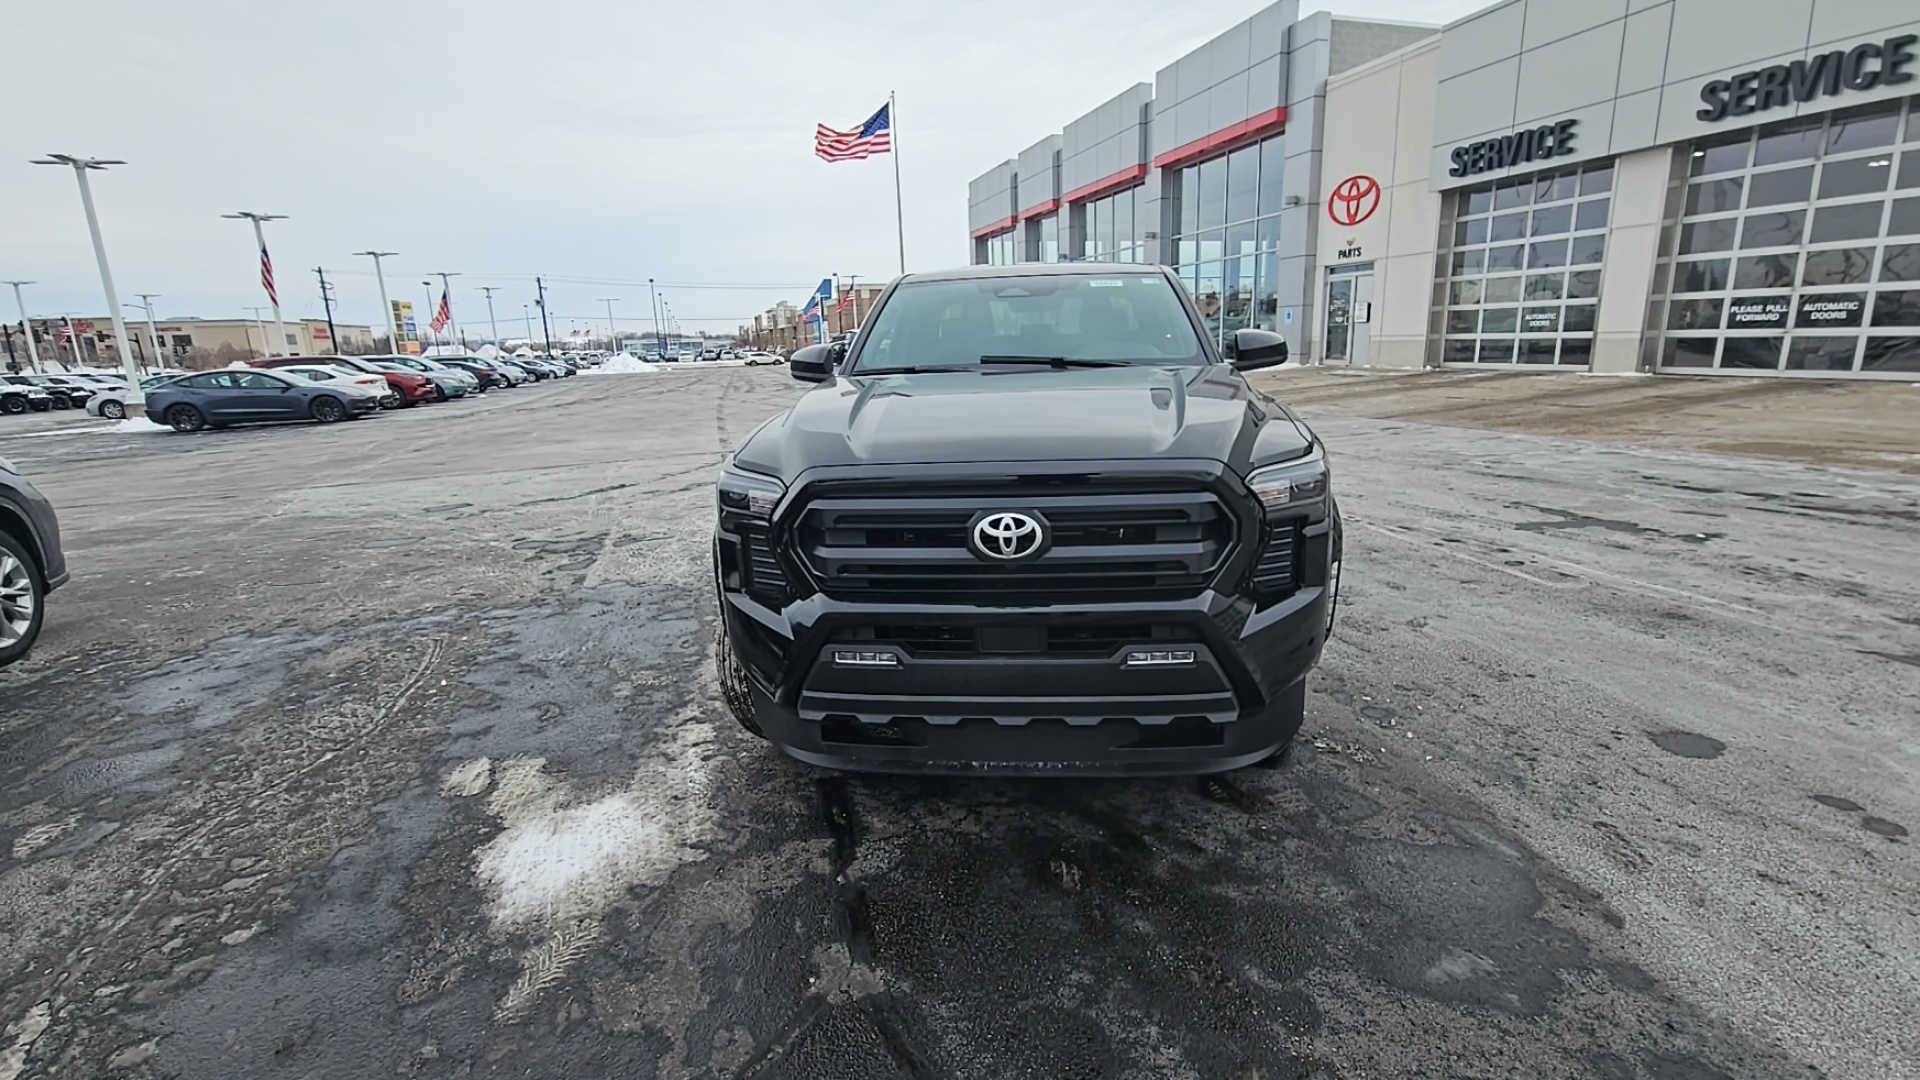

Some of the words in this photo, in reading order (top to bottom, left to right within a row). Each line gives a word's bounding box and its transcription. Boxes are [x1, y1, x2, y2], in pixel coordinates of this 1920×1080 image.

[1697, 34, 1918, 121] SERVICE
[1449, 119, 1578, 177] SERVICE
[1338, 247, 1361, 259] PARTS
[1730, 305, 1763, 313] PLEASE
[1766, 304, 1788, 312] PULL
[1803, 302, 1859, 311] AUTOMATIC
[1736, 313, 1780, 321] FORWARD
[1811, 311, 1847, 319] DOORS
